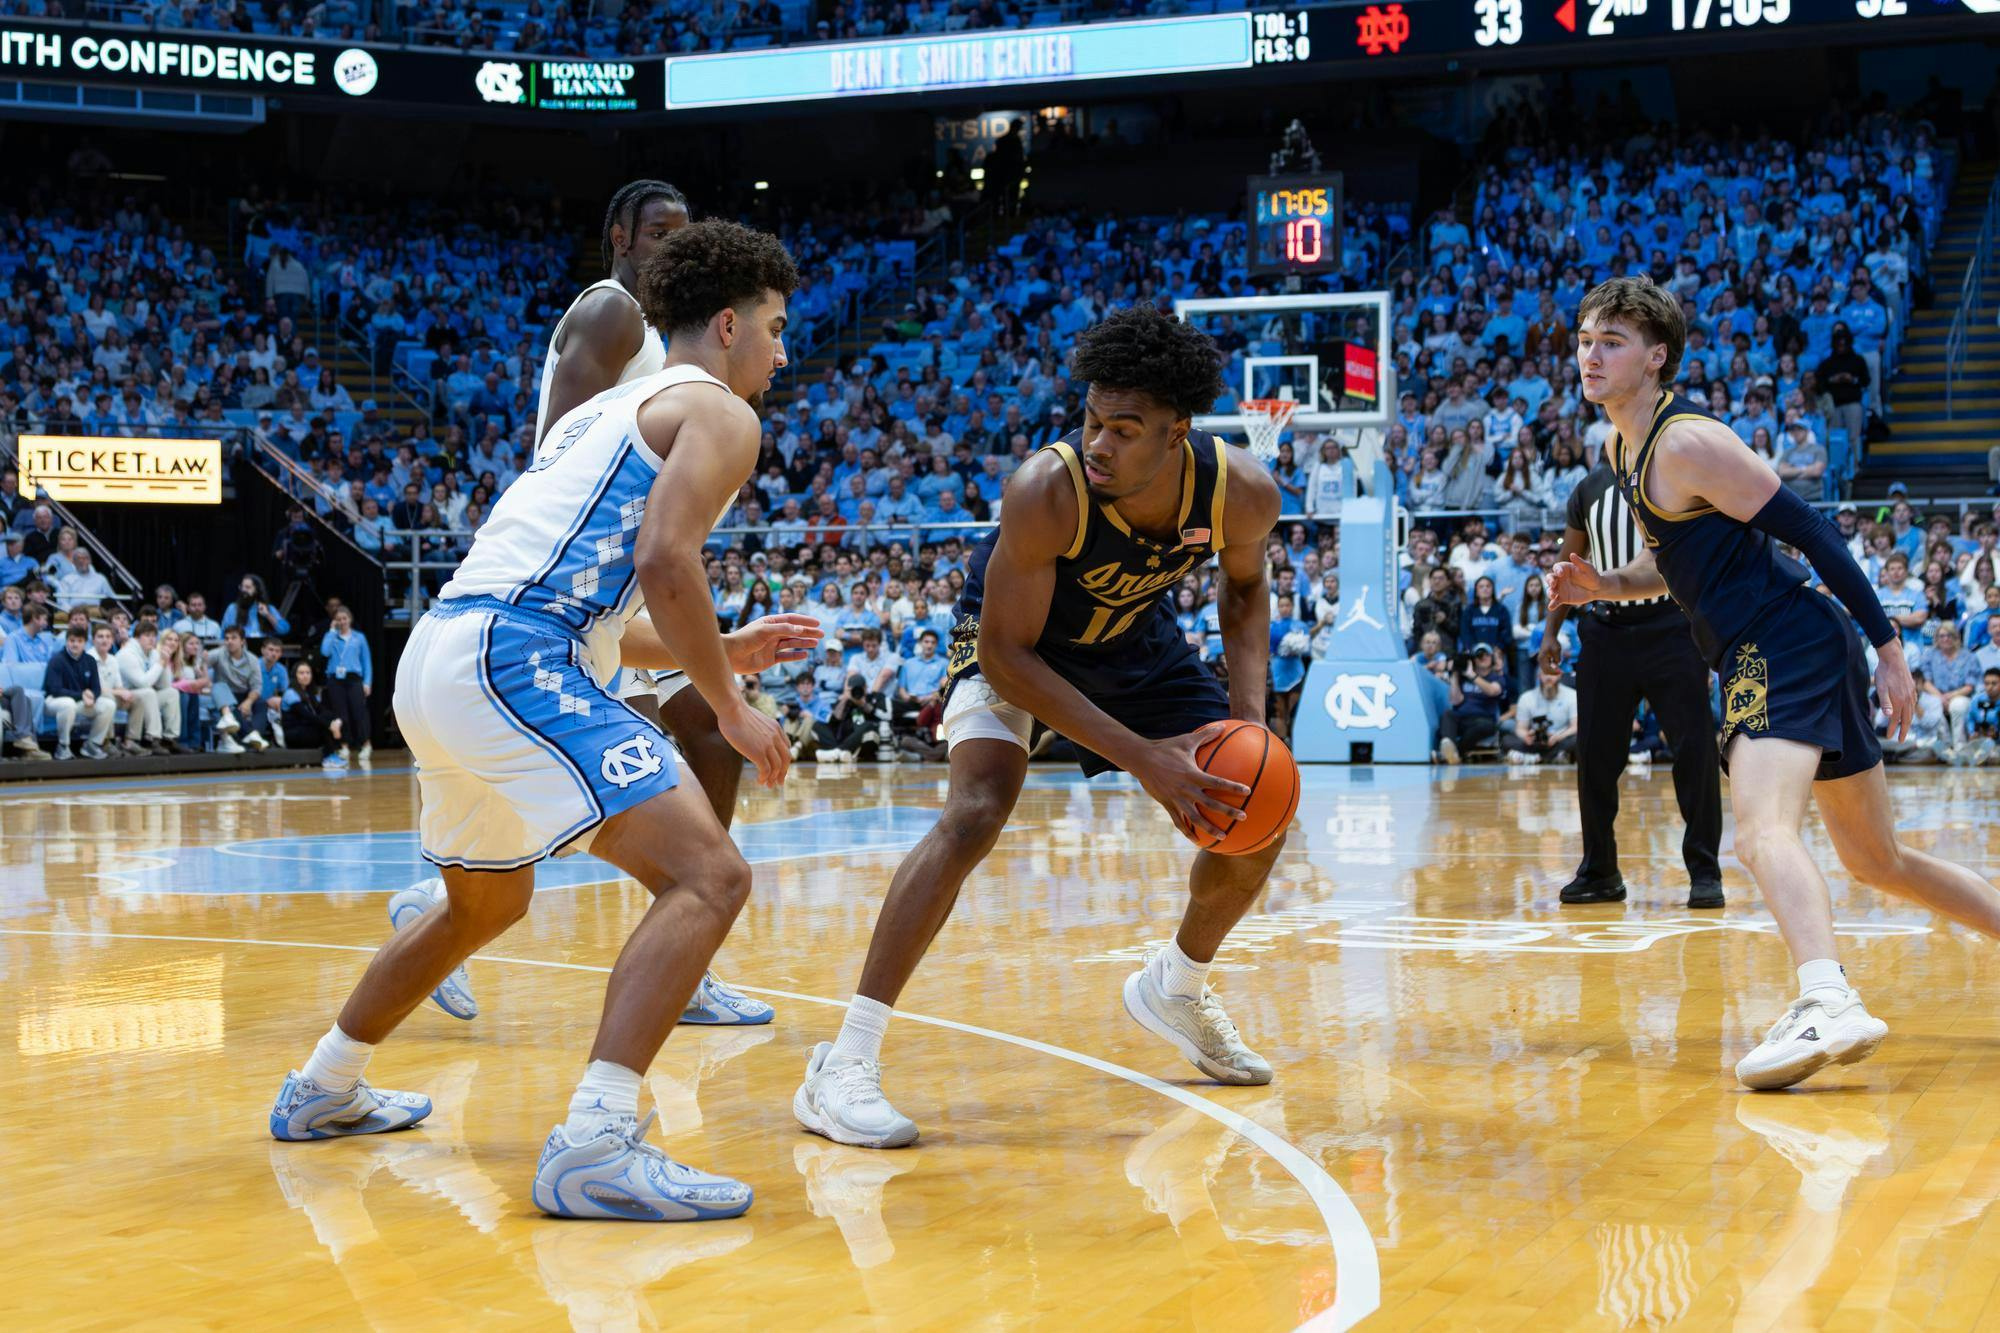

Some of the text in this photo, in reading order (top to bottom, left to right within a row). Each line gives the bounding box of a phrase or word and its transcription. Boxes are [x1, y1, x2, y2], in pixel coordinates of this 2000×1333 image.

[1254, 12, 1308, 38] TOL: 1
[1474, 0, 1523, 46] 33
[1, 31, 62, 68] ITH
[71, 36, 317, 85] CONFIDENCE
[831, 34, 1074, 91] DEAN E. SMITH CENTER
[1254, 38, 1294, 64] FLS:
[542, 62, 635, 80] HOWARD
[553, 79, 626, 96] HANNA
[1271, 188, 1328, 216] 17:05
[1287, 218, 1321, 263] 10
